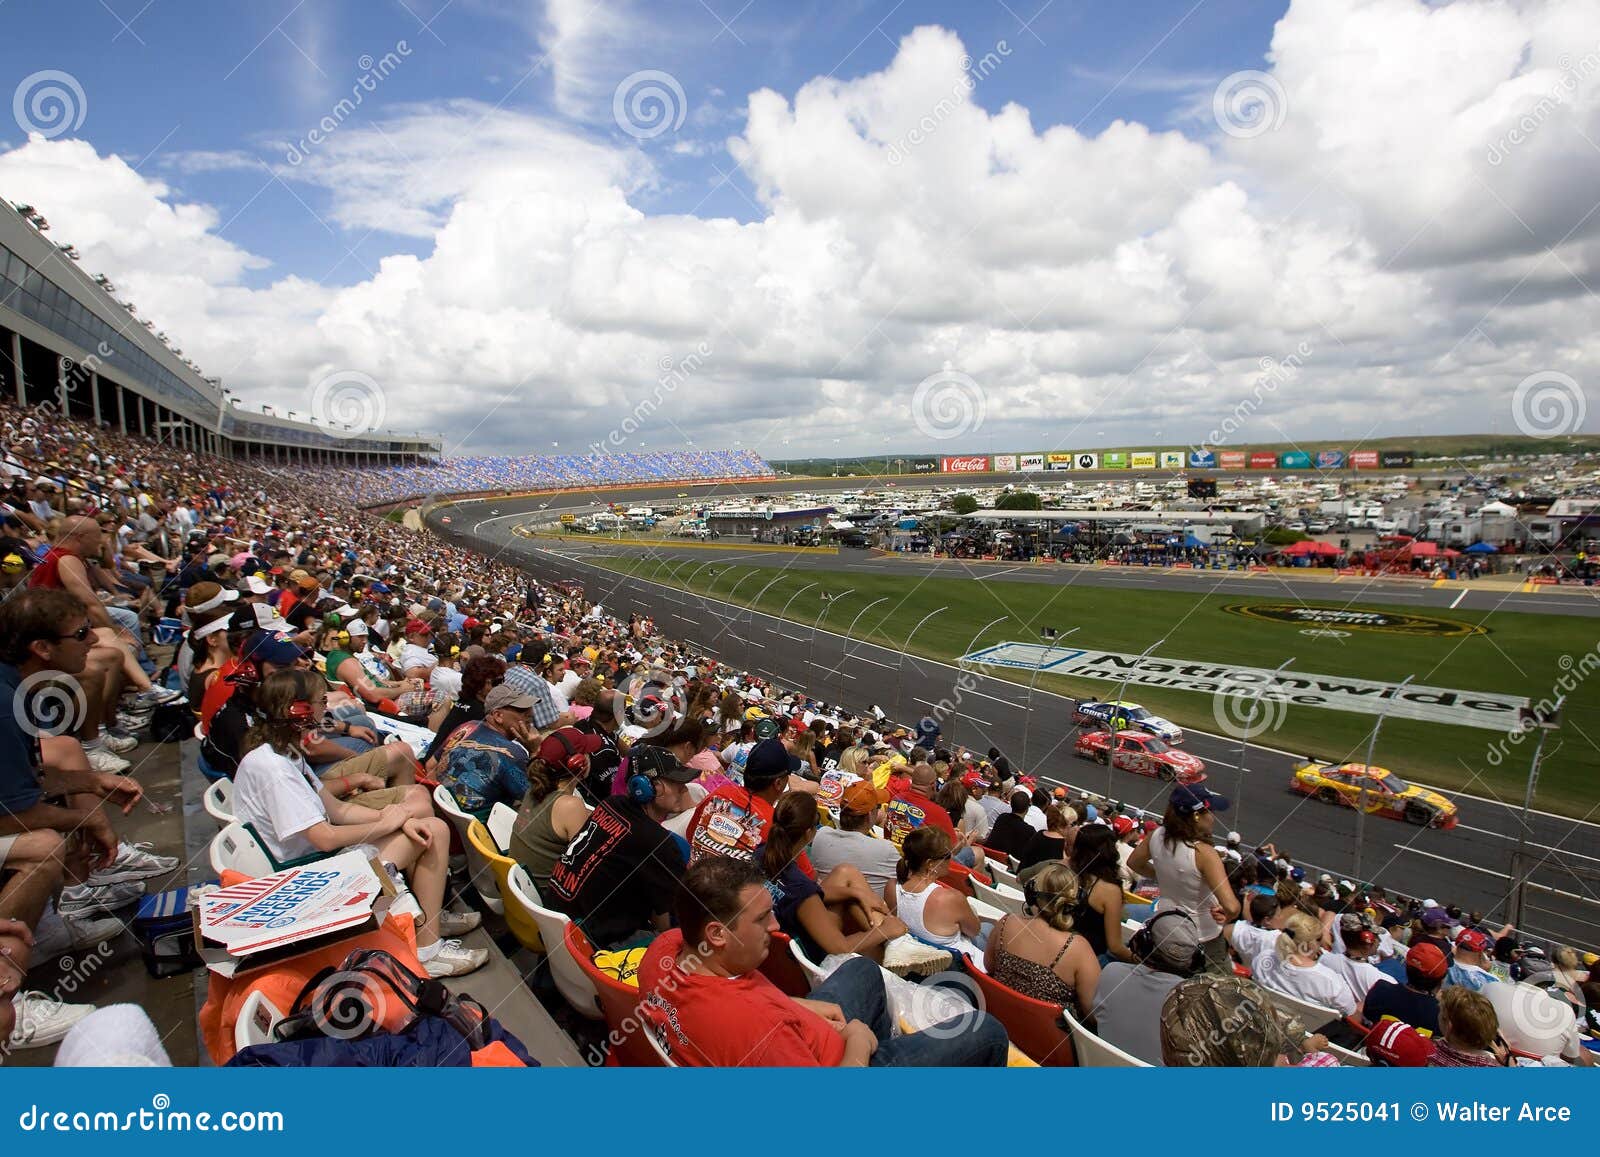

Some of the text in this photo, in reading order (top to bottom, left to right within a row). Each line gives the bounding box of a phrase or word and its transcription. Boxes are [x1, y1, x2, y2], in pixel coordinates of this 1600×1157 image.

[1068, 665, 1328, 705] Insurance
[1088, 654, 1515, 713] Nationwide
[233, 871, 320, 923] AMERICAN
[253, 871, 341, 924] LEGENDS
